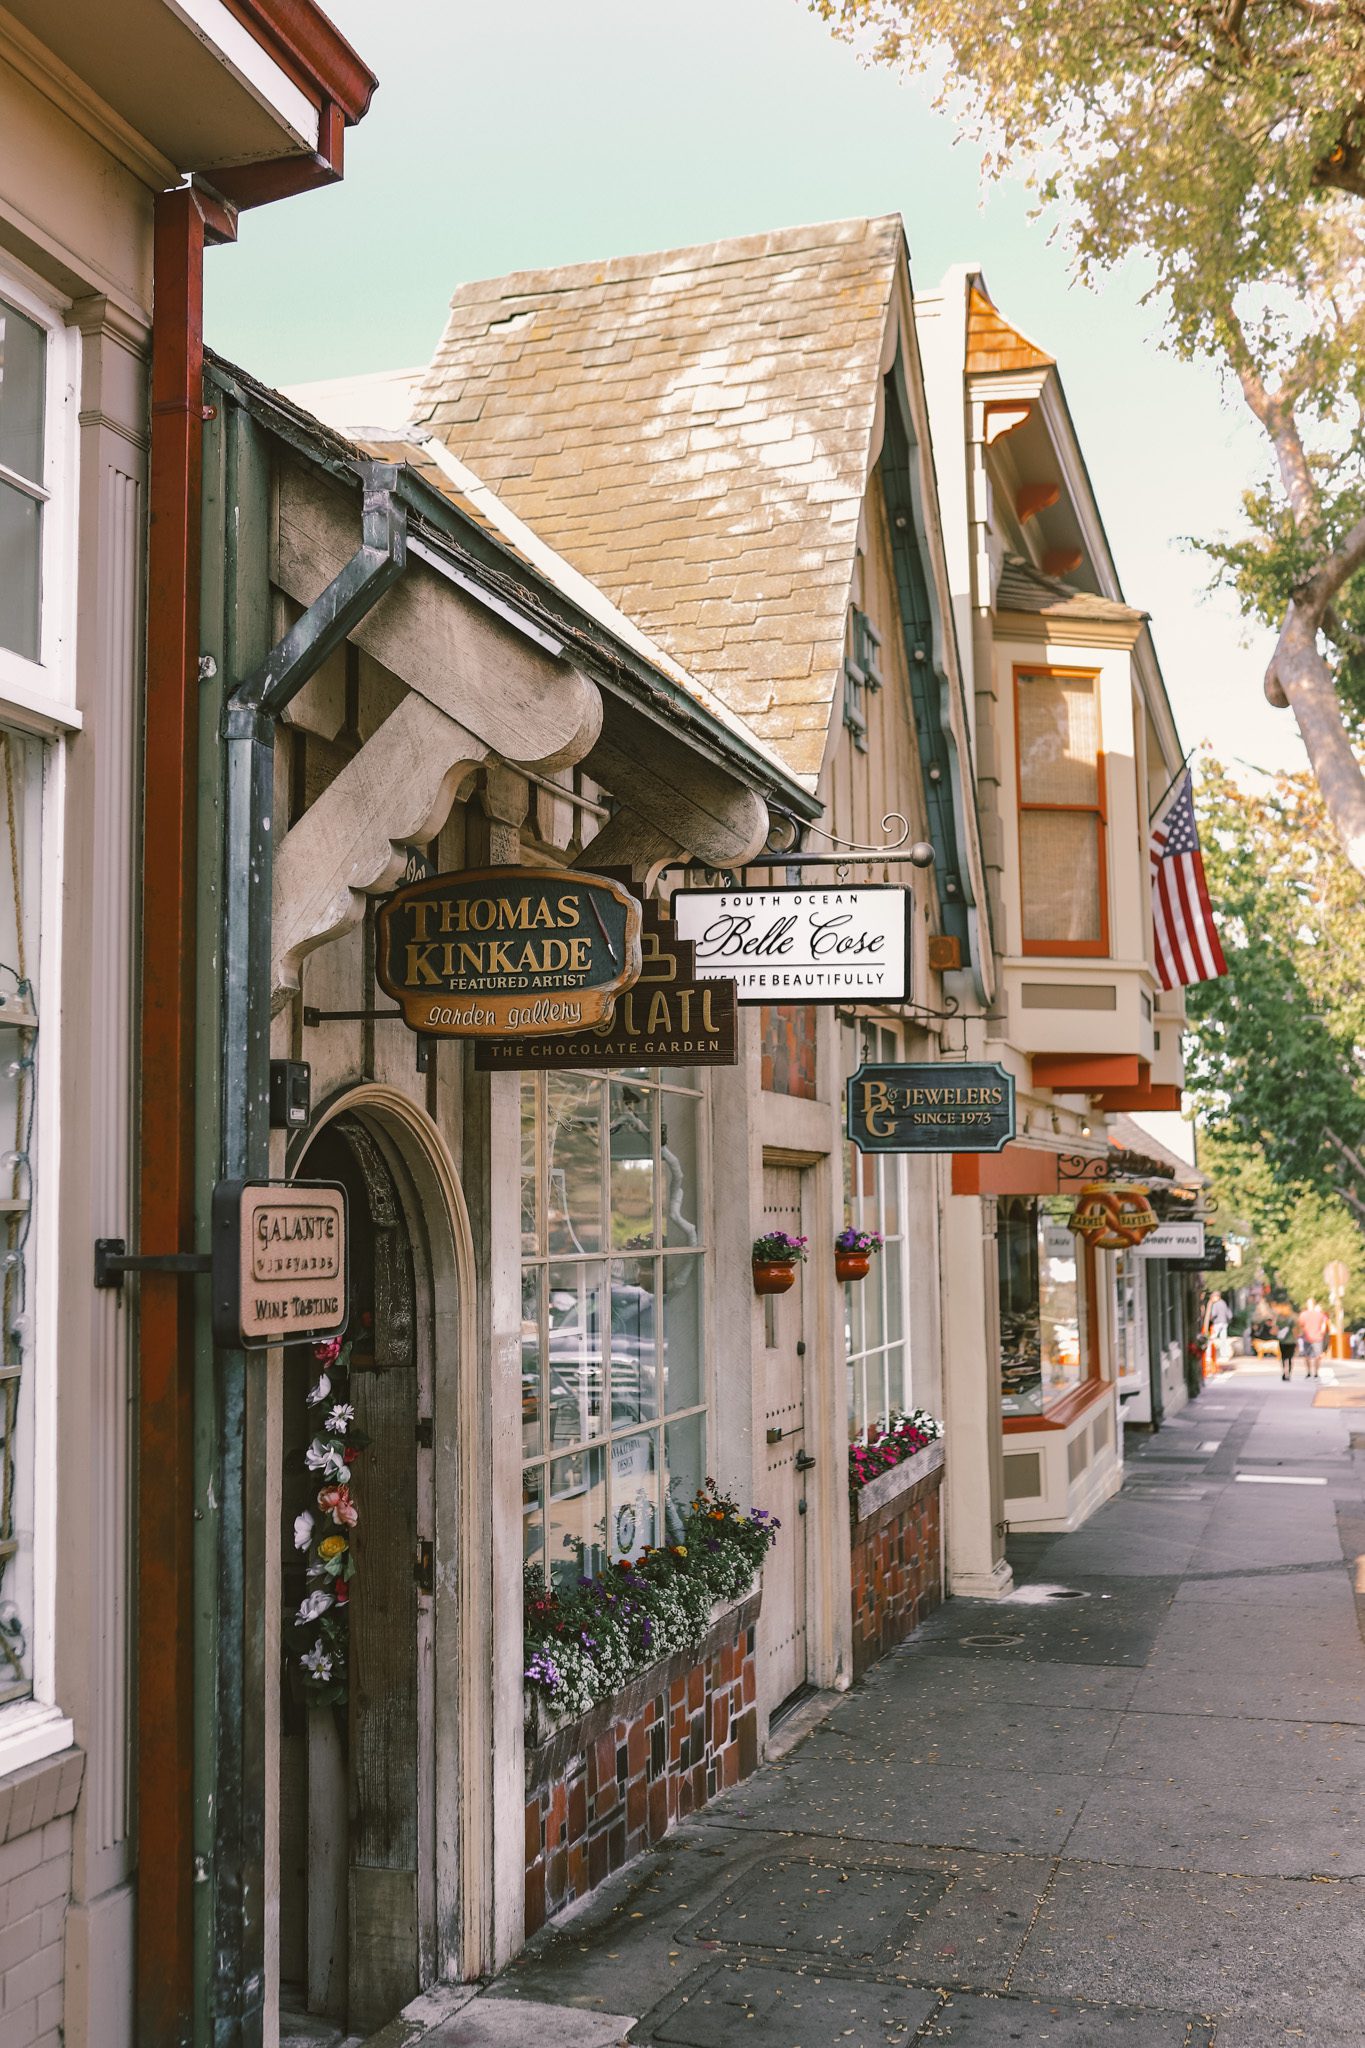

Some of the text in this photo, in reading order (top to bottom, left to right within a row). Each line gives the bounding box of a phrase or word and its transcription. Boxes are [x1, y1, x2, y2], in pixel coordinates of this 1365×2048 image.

[720, 894, 858, 906] SOUTH OCEAN
[404, 896, 580, 942] THOMAS
[695, 912, 885, 960] Belle Cose
[404, 937, 592, 985] KINKADE
[450, 974, 586, 990] FEATURED ARTIST
[772, 973, 885, 986] BEAUTIFULLY
[424, 999, 582, 1029] garden gallery
[492, 1040, 720, 1057] THE CHOCOLATE GARDEN
[902, 1087, 1003, 1110] JEWELERS
[913, 1112, 992, 1125] SINCE 1973
[258, 1214, 334, 1251] GALANTE
